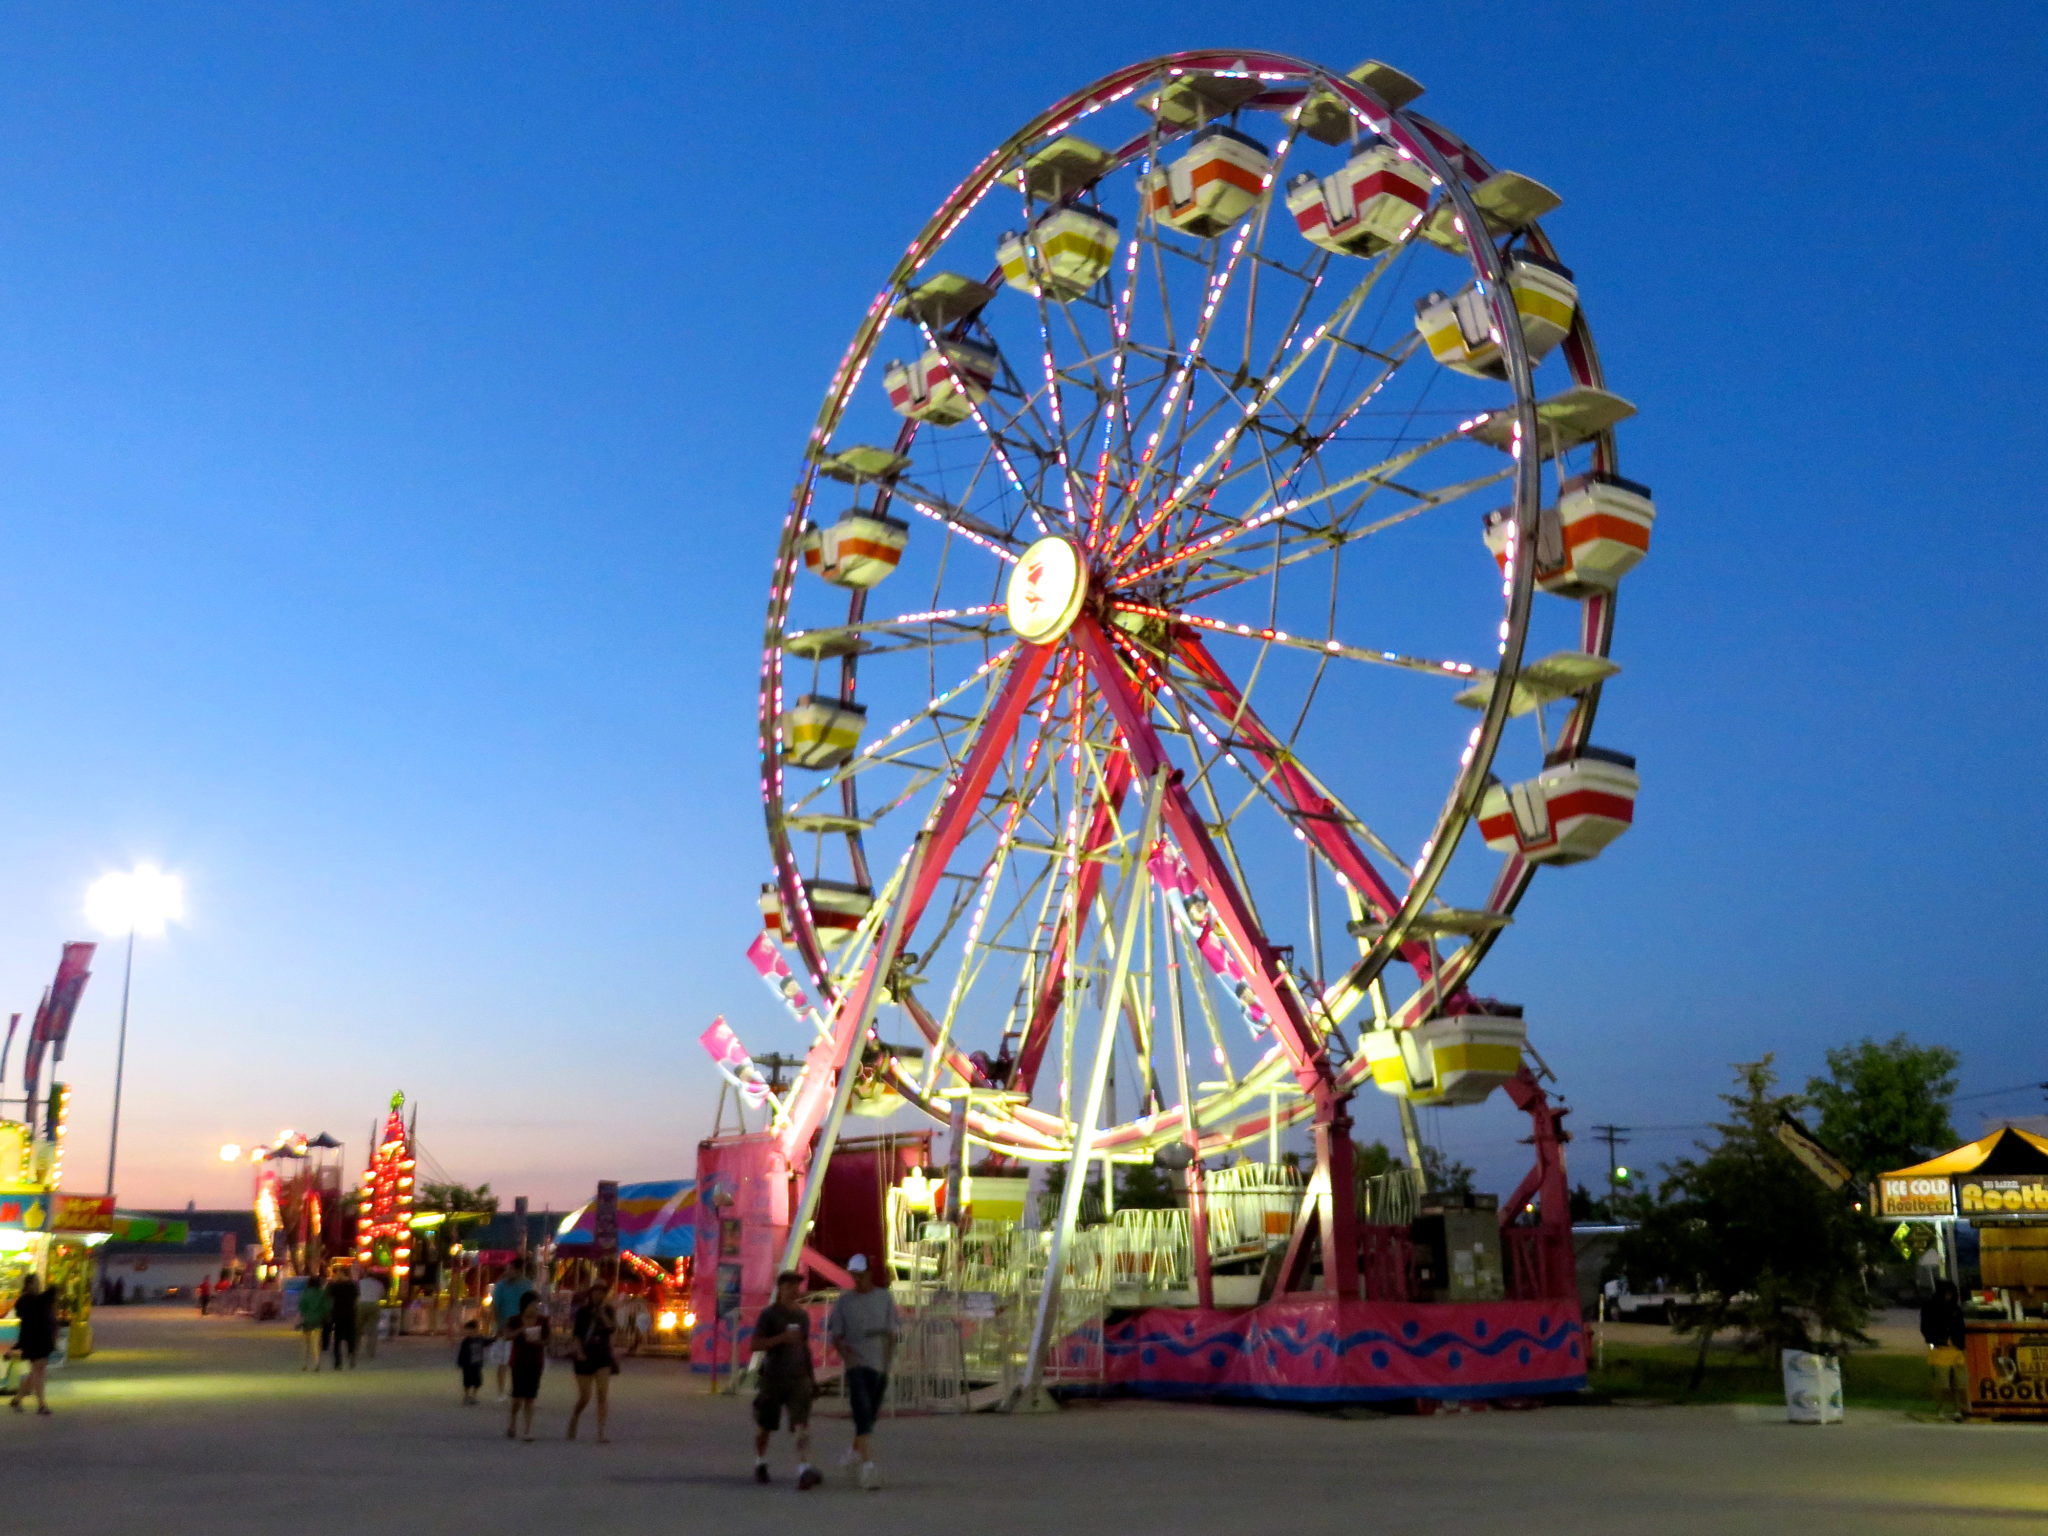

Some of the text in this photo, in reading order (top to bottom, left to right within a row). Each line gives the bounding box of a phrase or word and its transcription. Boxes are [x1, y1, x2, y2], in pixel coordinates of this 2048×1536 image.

[1886, 1179, 1949, 1196] ICE COLD
[1980, 1377, 2048, 1400] Root
